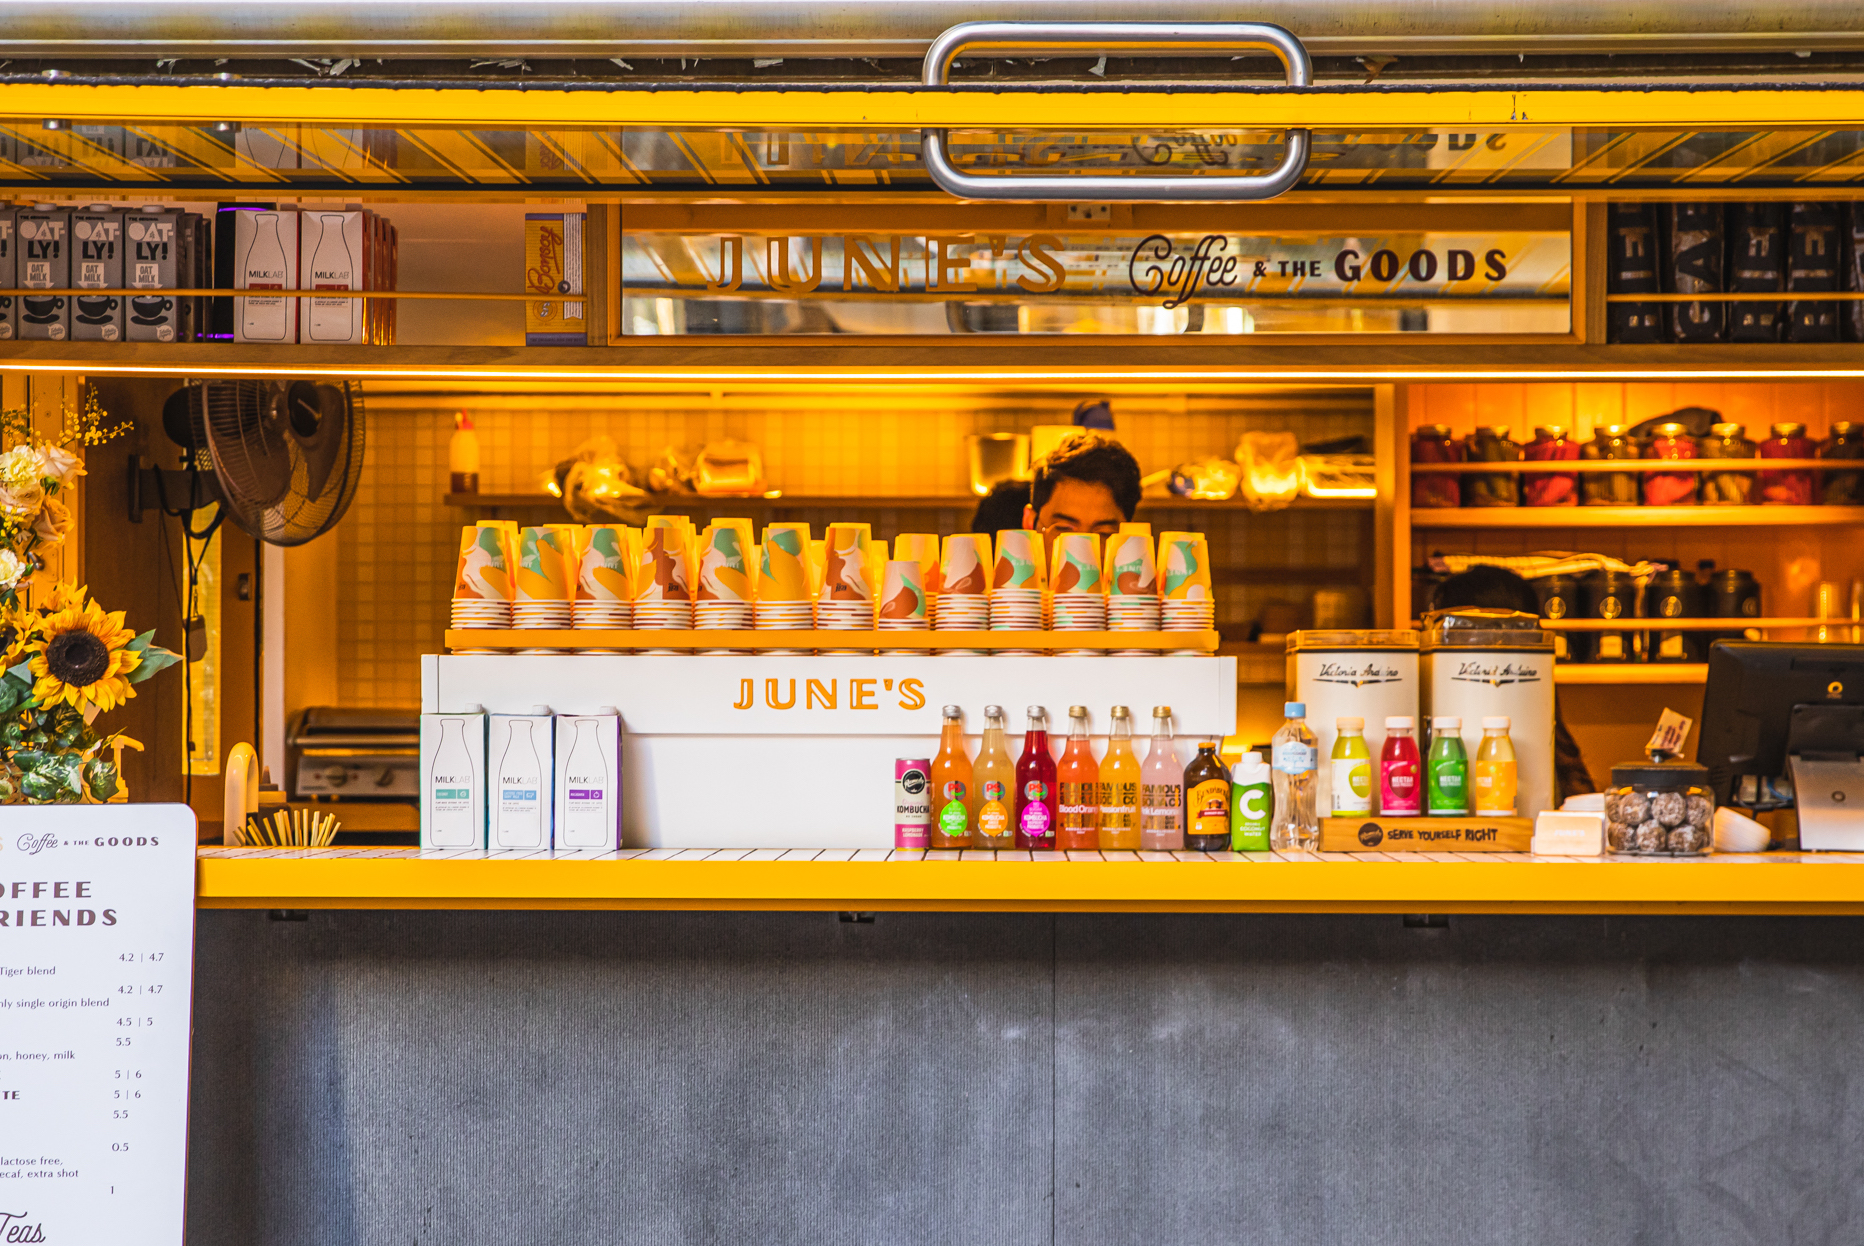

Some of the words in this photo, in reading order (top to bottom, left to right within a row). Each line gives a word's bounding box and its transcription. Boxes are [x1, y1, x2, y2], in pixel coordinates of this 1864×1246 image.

[27, 240, 60, 259] LY!
[82, 241, 115, 260] LY!
[136, 242, 168, 261] LY!
[527, 225, 563, 294] Bonsoy
[31, 264, 44, 272] OAT
[86, 265, 99, 274] OAT
[139, 266, 152, 274] OAT
[706, 233, 1067, 293] JUNE'S
[1129, 233, 1238, 310] Coffee
[1253, 261, 1267, 277] &
[1278, 260, 1322, 277] THE
[1334, 248, 1508, 282] GOODS
[29, 273, 47, 281] MILK
[84, 274, 102, 282] MILK
[137, 275, 155, 283] MILK
[1319, 662, 1357, 677] Victoria
[1360, 663, 1399, 677] Arduino
[1457, 662, 1498, 677] Victoria
[1499, 663, 1538, 677] Arduino
[733, 678, 927, 711] JUNE'S
[897, 805, 930, 813] KOMBUCHA
[1059, 804, 1078, 813] Blood
[1387, 829, 1414, 840] SERVE
[1417, 829, 1462, 841] YOURSELF
[1465, 828, 1498, 841] RIGHT
[16, 833, 59, 856] Coffee
[94, 836, 159, 847] GOODS
[119, 953, 134, 962] 4.2
[149, 953, 165, 962] 4.7
[27, 966, 56, 975] blend
[118, 985, 133, 994] 4.2
[148, 985, 163, 994] 4.7
[17, 998, 45, 1010] single
[49, 998, 77, 1009] origin
[81, 998, 110, 1007] blend
[116, 1017, 132, 1026] 4.5
[147, 1017, 153, 1026] 5
[116, 1037, 131, 1047] 5.5
[15, 1050, 50, 1062] honey,
[54, 1050, 75, 1060] milk
[115, 1070, 121, 1079] 5
[136, 1070, 142, 1079] 6
[114, 1090, 120, 1099] 5
[135, 1089, 141, 1099] 6
[113, 1110, 129, 1119] 5.5
[112, 1142, 129, 1152] 0.5
[1, 1156, 37, 1166] lactose
[40, 1156, 63, 1166] free,
[27, 1170, 53, 1178] extra
[57, 1168, 79, 1178] shot
[110, 1185, 115, 1195] 1
[0, 1211, 46, 1244] Teas
